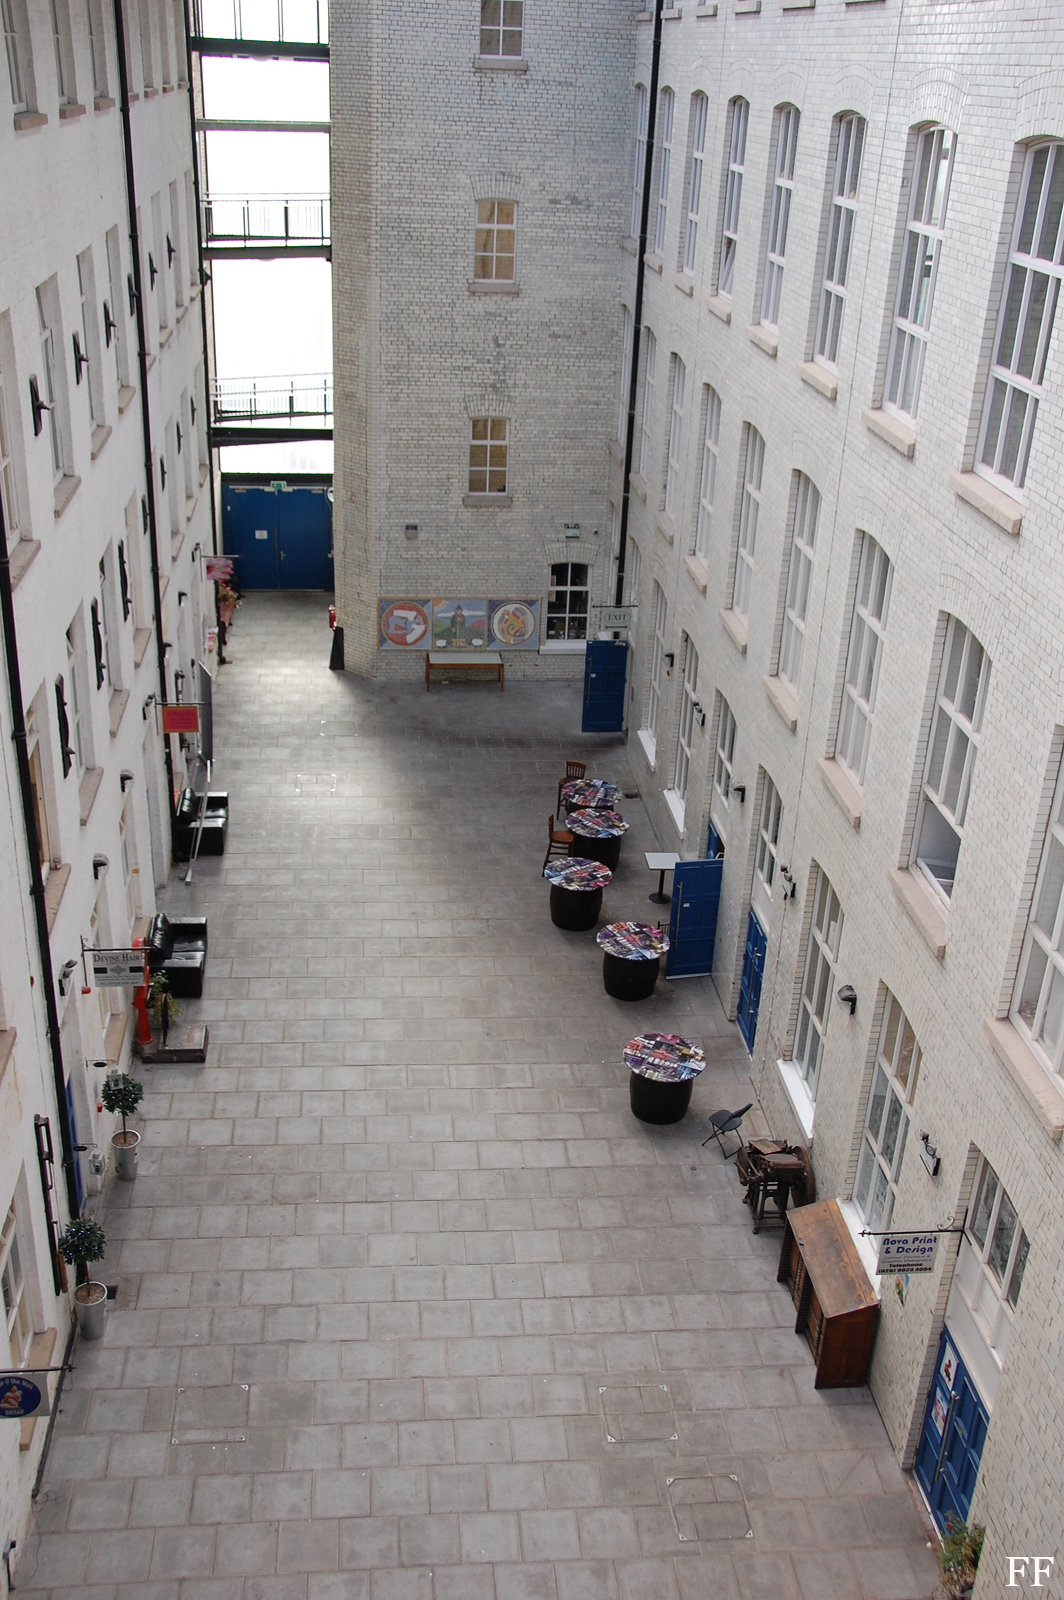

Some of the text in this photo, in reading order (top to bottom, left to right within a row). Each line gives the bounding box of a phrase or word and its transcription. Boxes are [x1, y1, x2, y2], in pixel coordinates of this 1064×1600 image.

[122, 953, 140, 961] HAIR
[883, 1236, 937, 1246] Nova Print
[896, 1245, 933, 1255] Design
